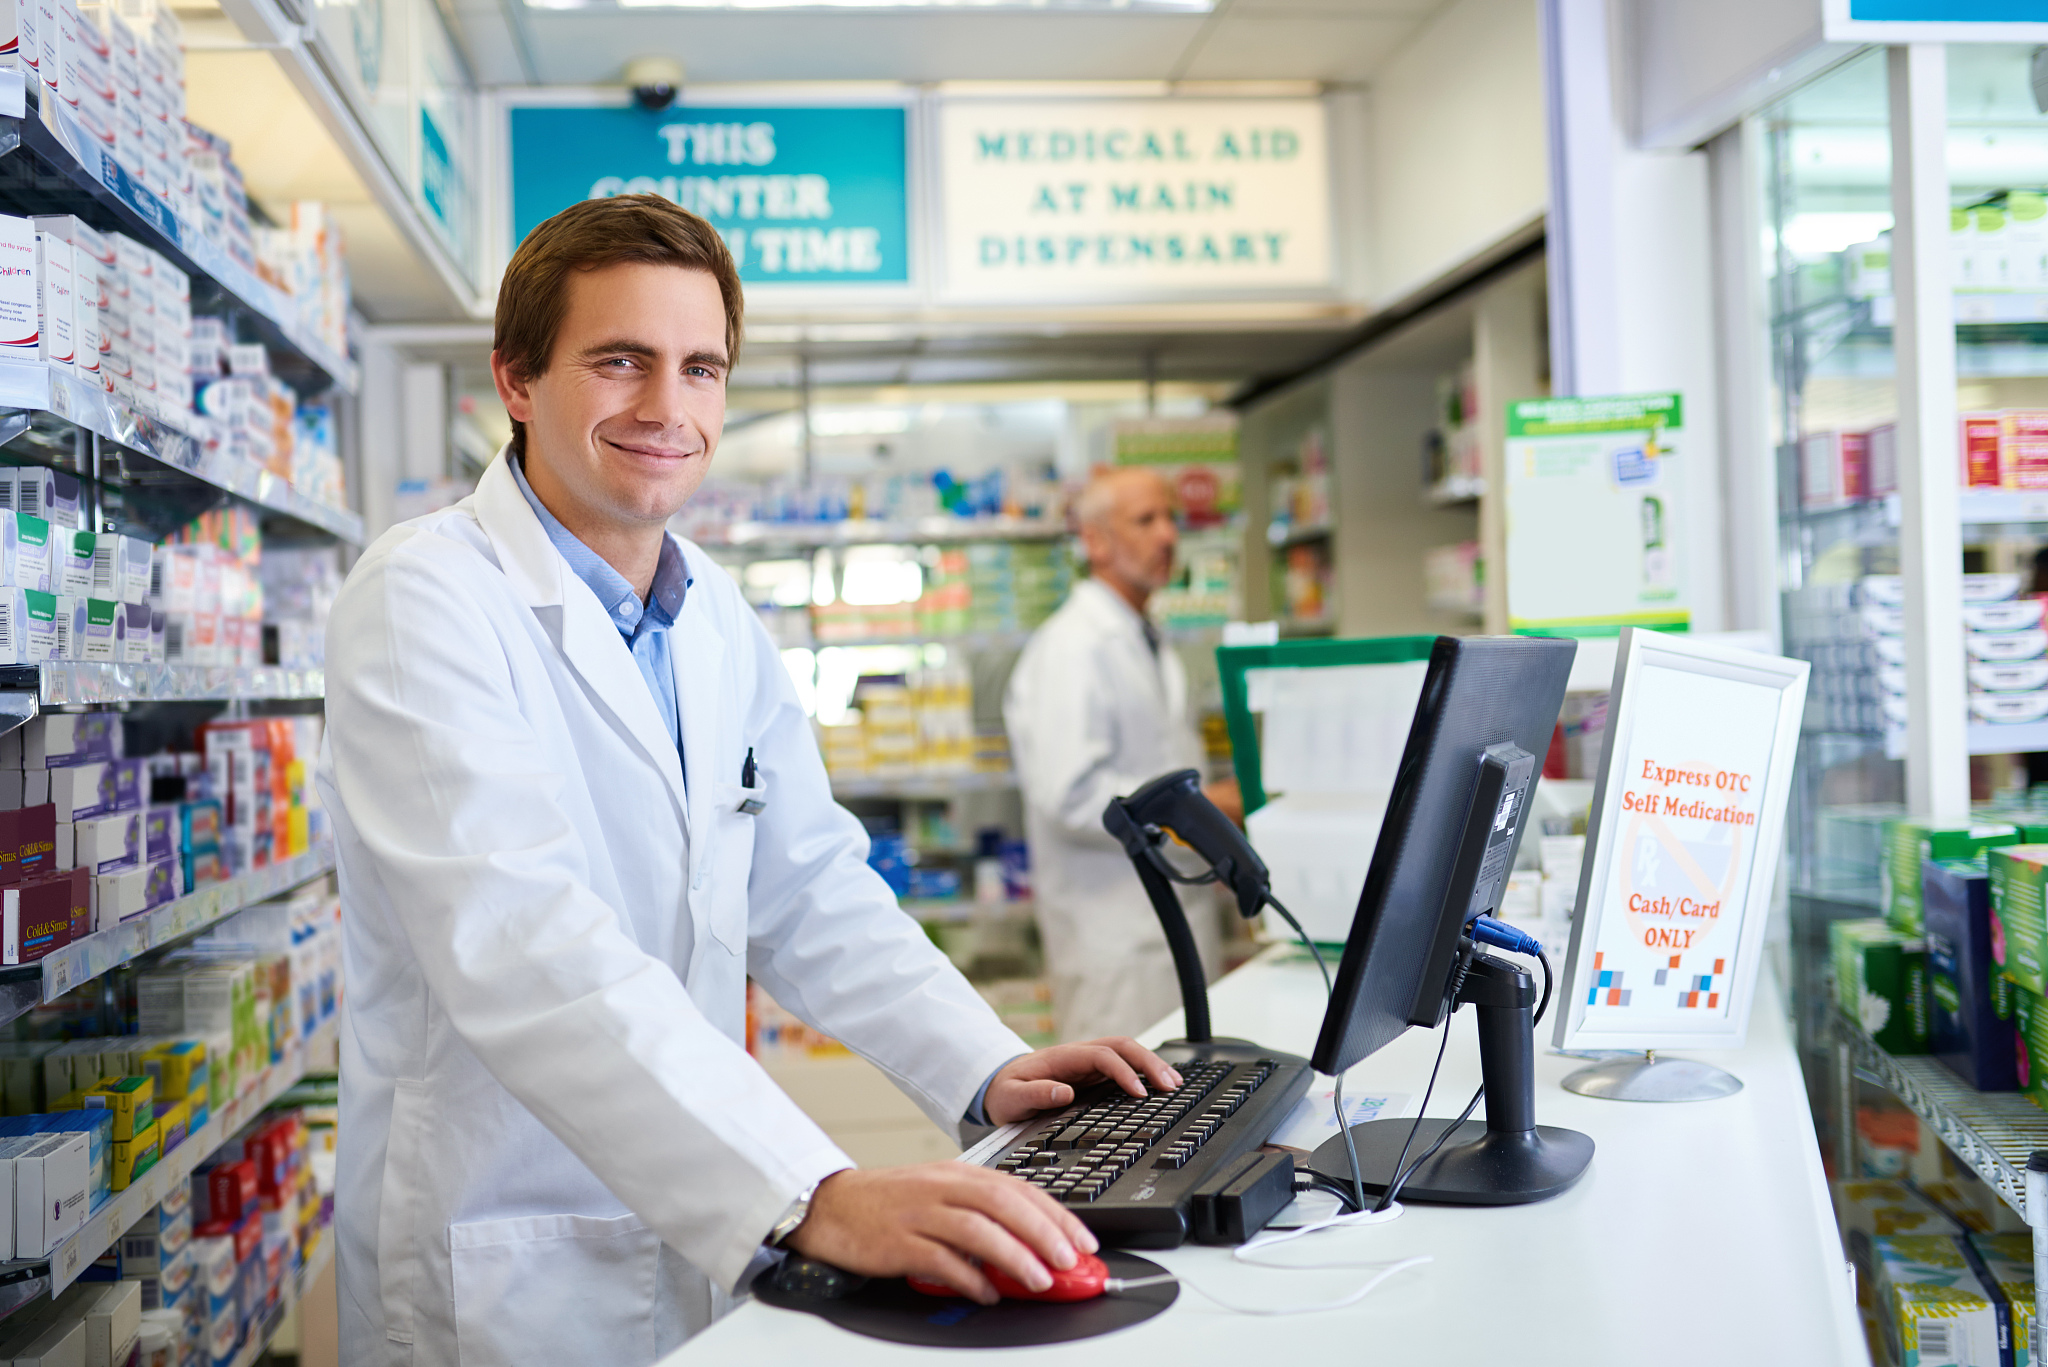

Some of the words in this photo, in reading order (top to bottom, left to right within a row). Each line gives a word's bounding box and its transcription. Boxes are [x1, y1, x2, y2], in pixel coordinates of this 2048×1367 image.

[657, 121, 777, 167] THIS
[975, 128, 1198, 162] MEDICAL
[1211, 128, 1303, 162] AID
[1030, 182, 1092, 215] AT
[1105, 180, 1237, 214] MAIN
[751, 225, 883, 274] TIME
[976, 231, 1290, 268] DISPENSARY
[1642, 759, 1711, 787] Express
[1715, 771, 1751, 792] OTC
[1622, 791, 1660, 814] Self
[1663, 796, 1755, 825] Medication
[1628, 893, 1720, 921] Cash/Card
[1644, 927, 1696, 949] ONLY
